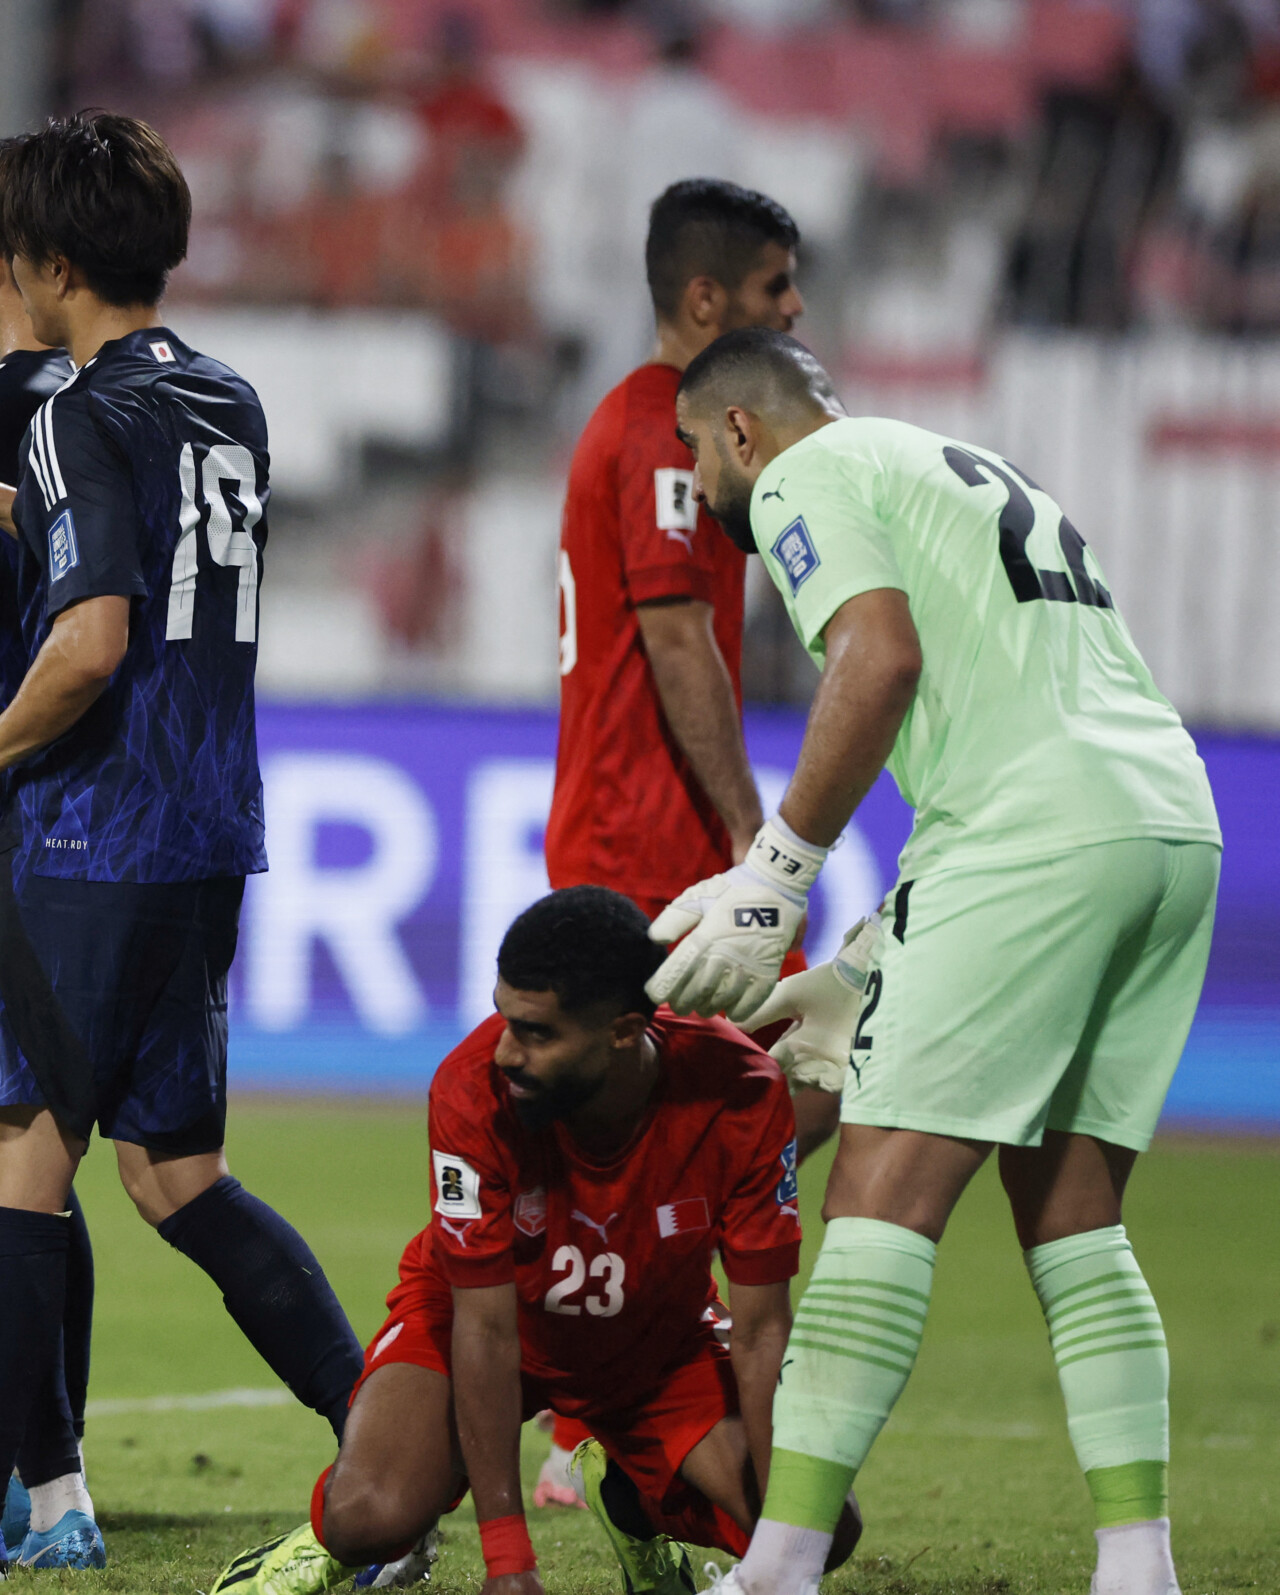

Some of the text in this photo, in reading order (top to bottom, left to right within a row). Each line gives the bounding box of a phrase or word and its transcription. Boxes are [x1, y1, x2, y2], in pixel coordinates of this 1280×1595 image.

[165, 441, 263, 643] 19
[45, 837, 88, 851] HEAT.RDY
[544, 1244, 626, 1318] 23
